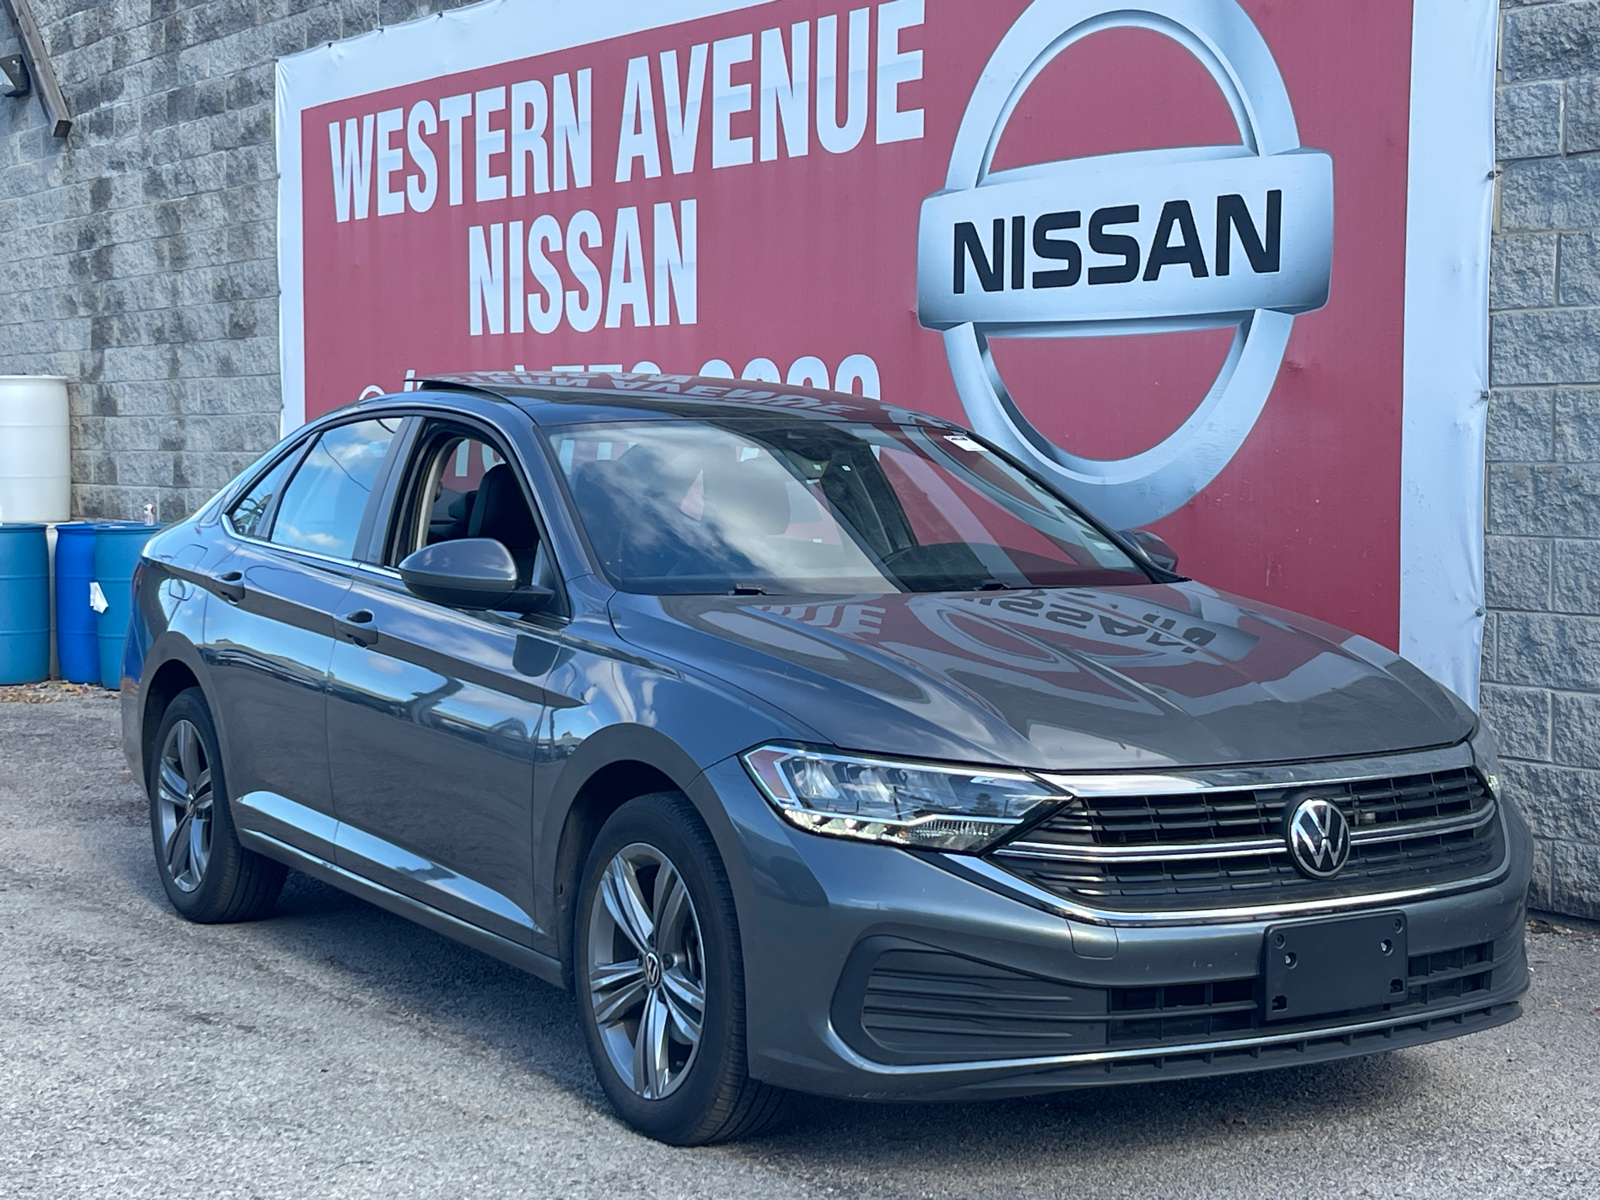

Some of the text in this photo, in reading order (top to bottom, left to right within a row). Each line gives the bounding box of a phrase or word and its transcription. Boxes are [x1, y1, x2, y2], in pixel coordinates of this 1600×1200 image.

[329, 0, 925, 223] WESTERN AVENUE
[468, 198, 698, 336] NISSAN
[953, 188, 1282, 295] NISSAN
[1290, 799, 1351, 878] VW
